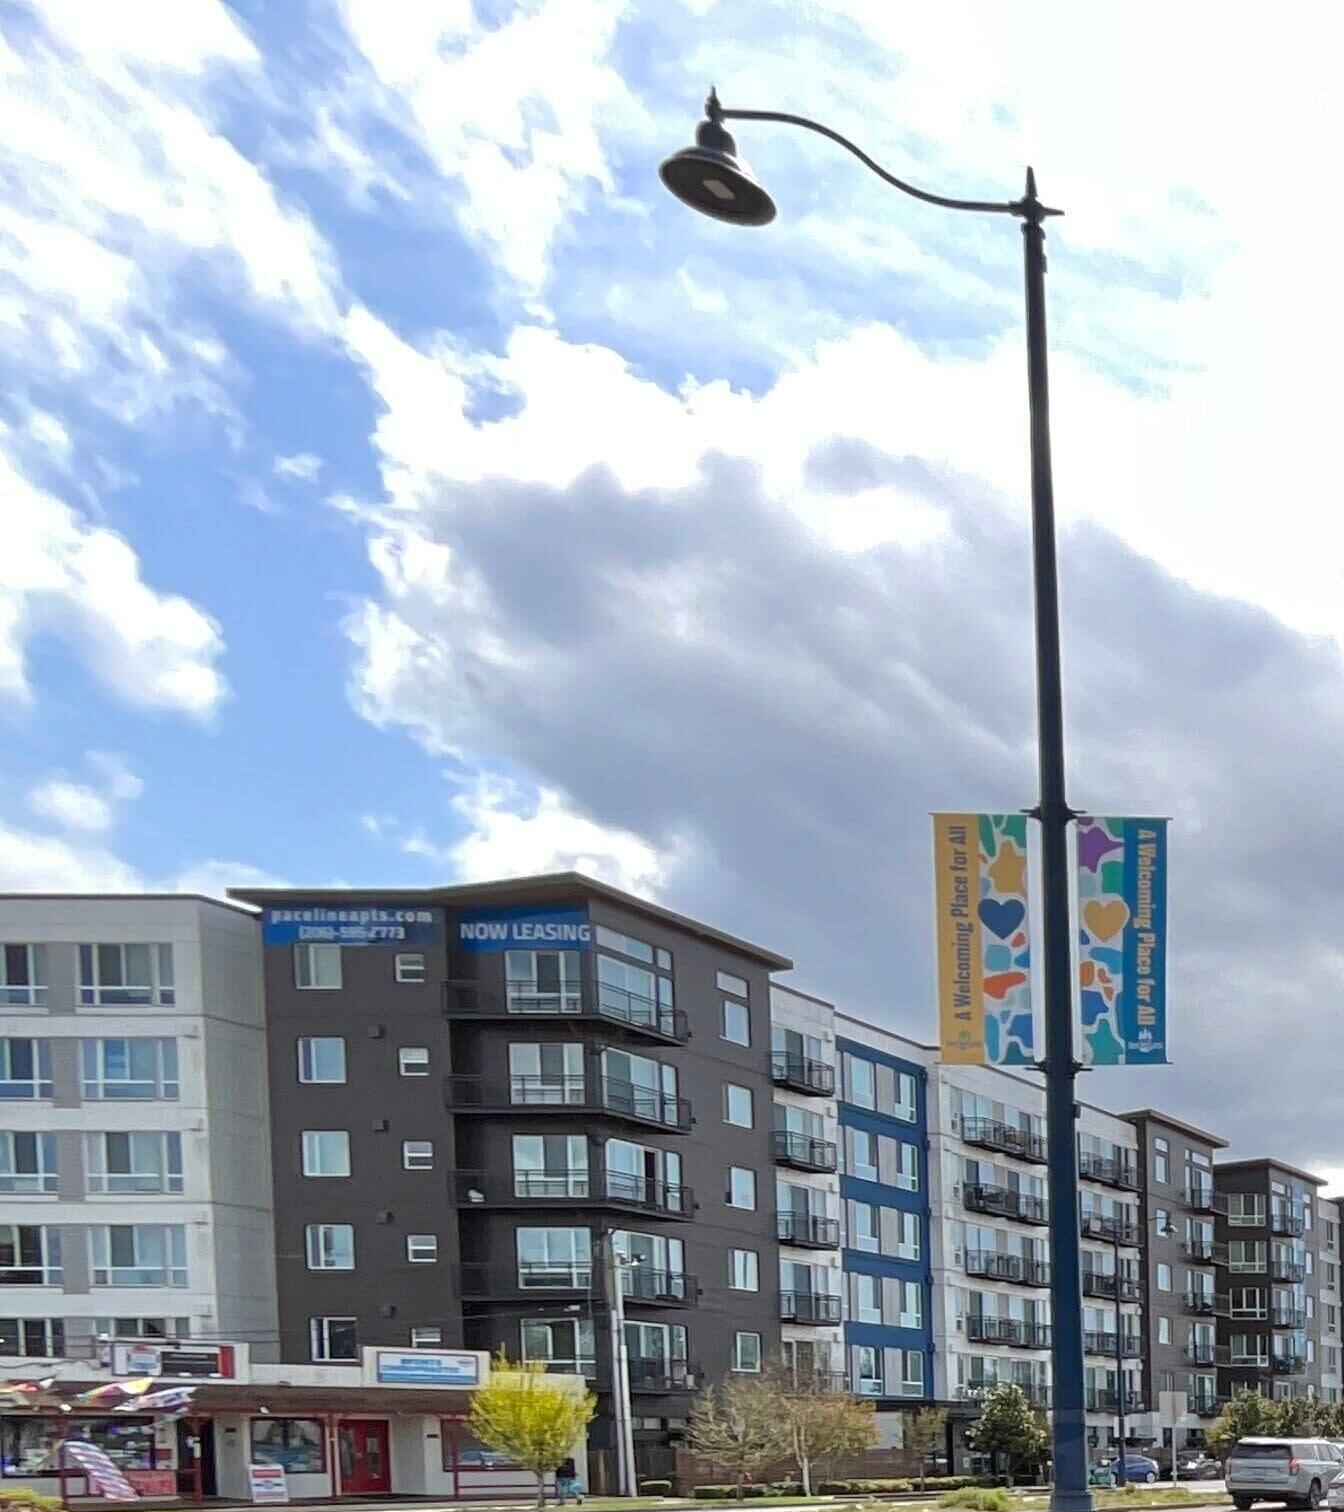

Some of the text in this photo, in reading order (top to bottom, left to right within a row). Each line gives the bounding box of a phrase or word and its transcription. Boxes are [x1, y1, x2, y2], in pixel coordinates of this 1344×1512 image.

[949, 826, 966, 845] All
[950, 849, 968, 871] for
[951, 875, 969, 918] Place
[1134, 843, 1157, 929] Welcoming
[271, 908, 433, 925] pacelineapts.com
[460, 923, 591, 942] NOW LEASING
[952, 922, 973, 1007] Welcoming
[1136, 933, 1156, 974] Place
[1136, 979, 1155, 1002] for
[954, 1009, 971, 1021] A
[1137, 1005, 1156, 1025] All
